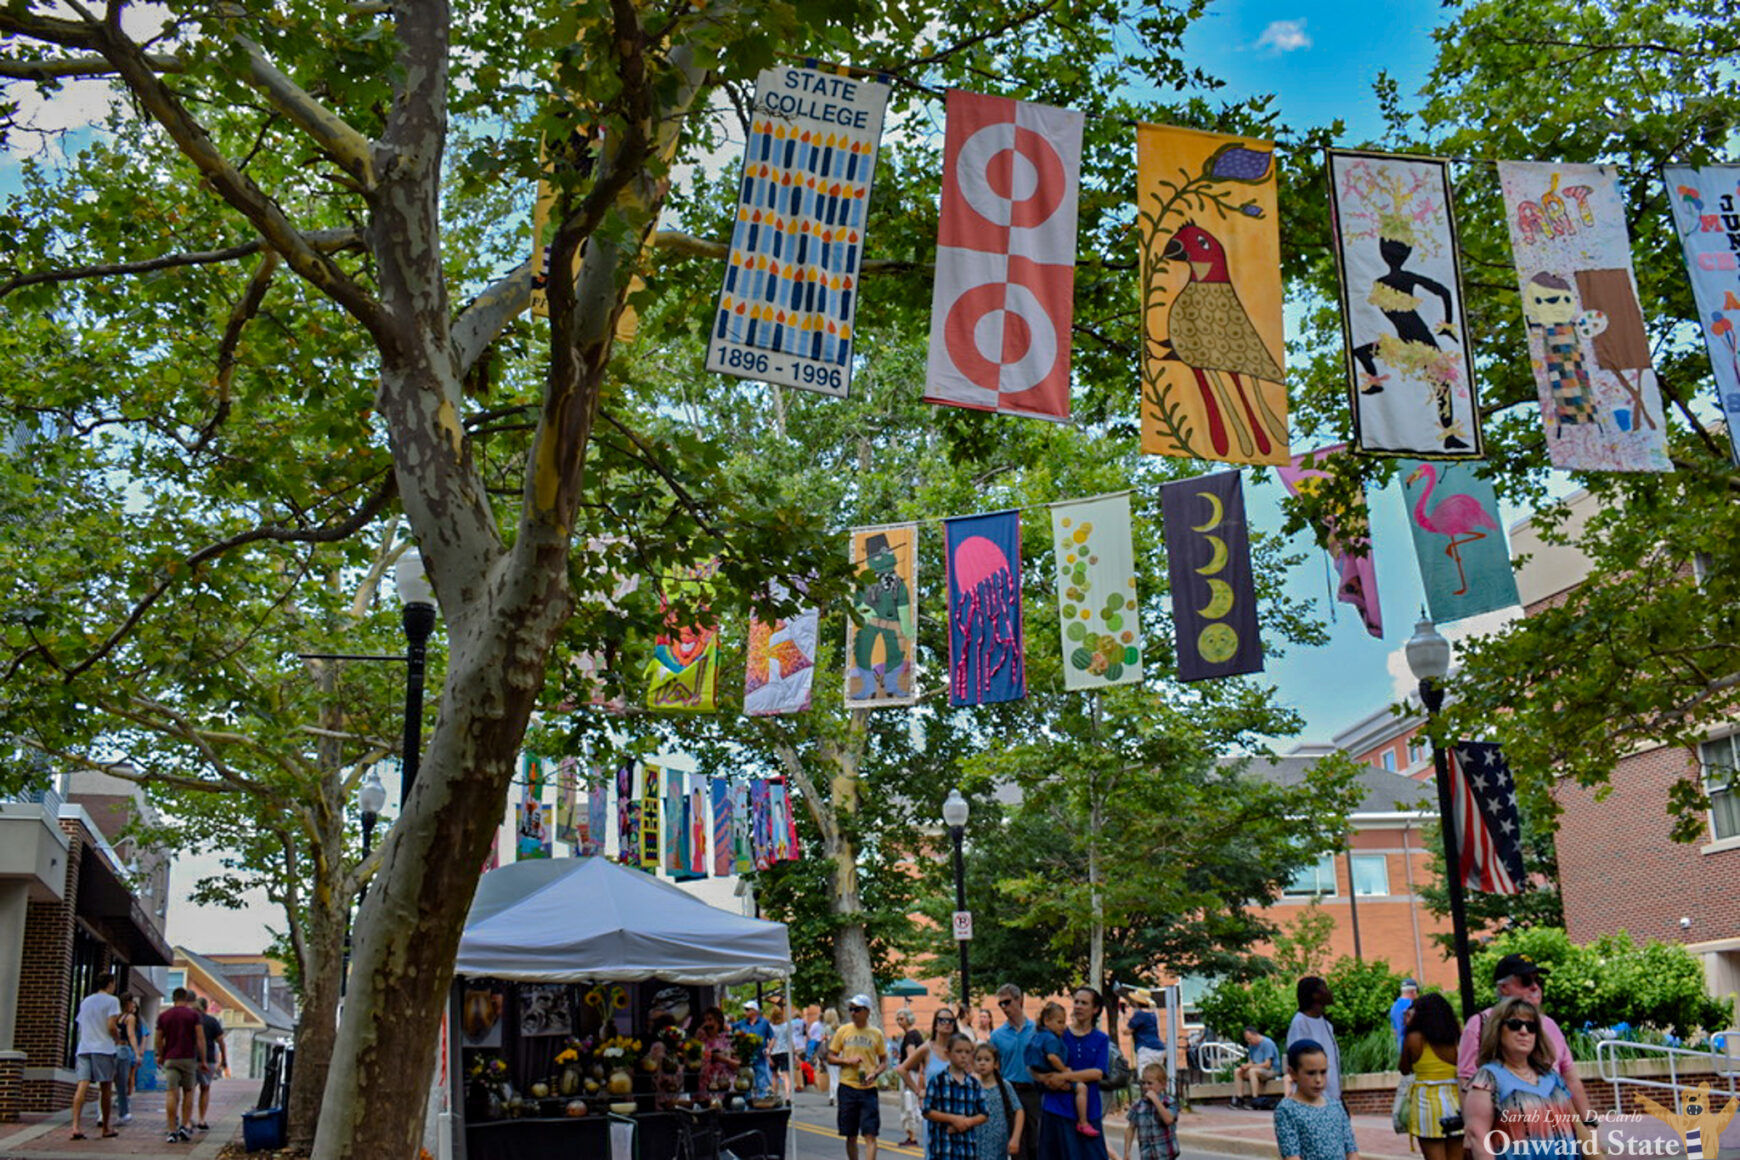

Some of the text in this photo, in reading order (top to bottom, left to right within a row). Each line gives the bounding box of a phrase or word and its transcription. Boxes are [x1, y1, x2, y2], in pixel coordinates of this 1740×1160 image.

[785, 71, 857, 102] STATE
[765, 92, 868, 129] COLLEGE
[1517, 173, 1595, 245] ART
[717, 346, 769, 373] 1896
[791, 361, 842, 389] 1996
